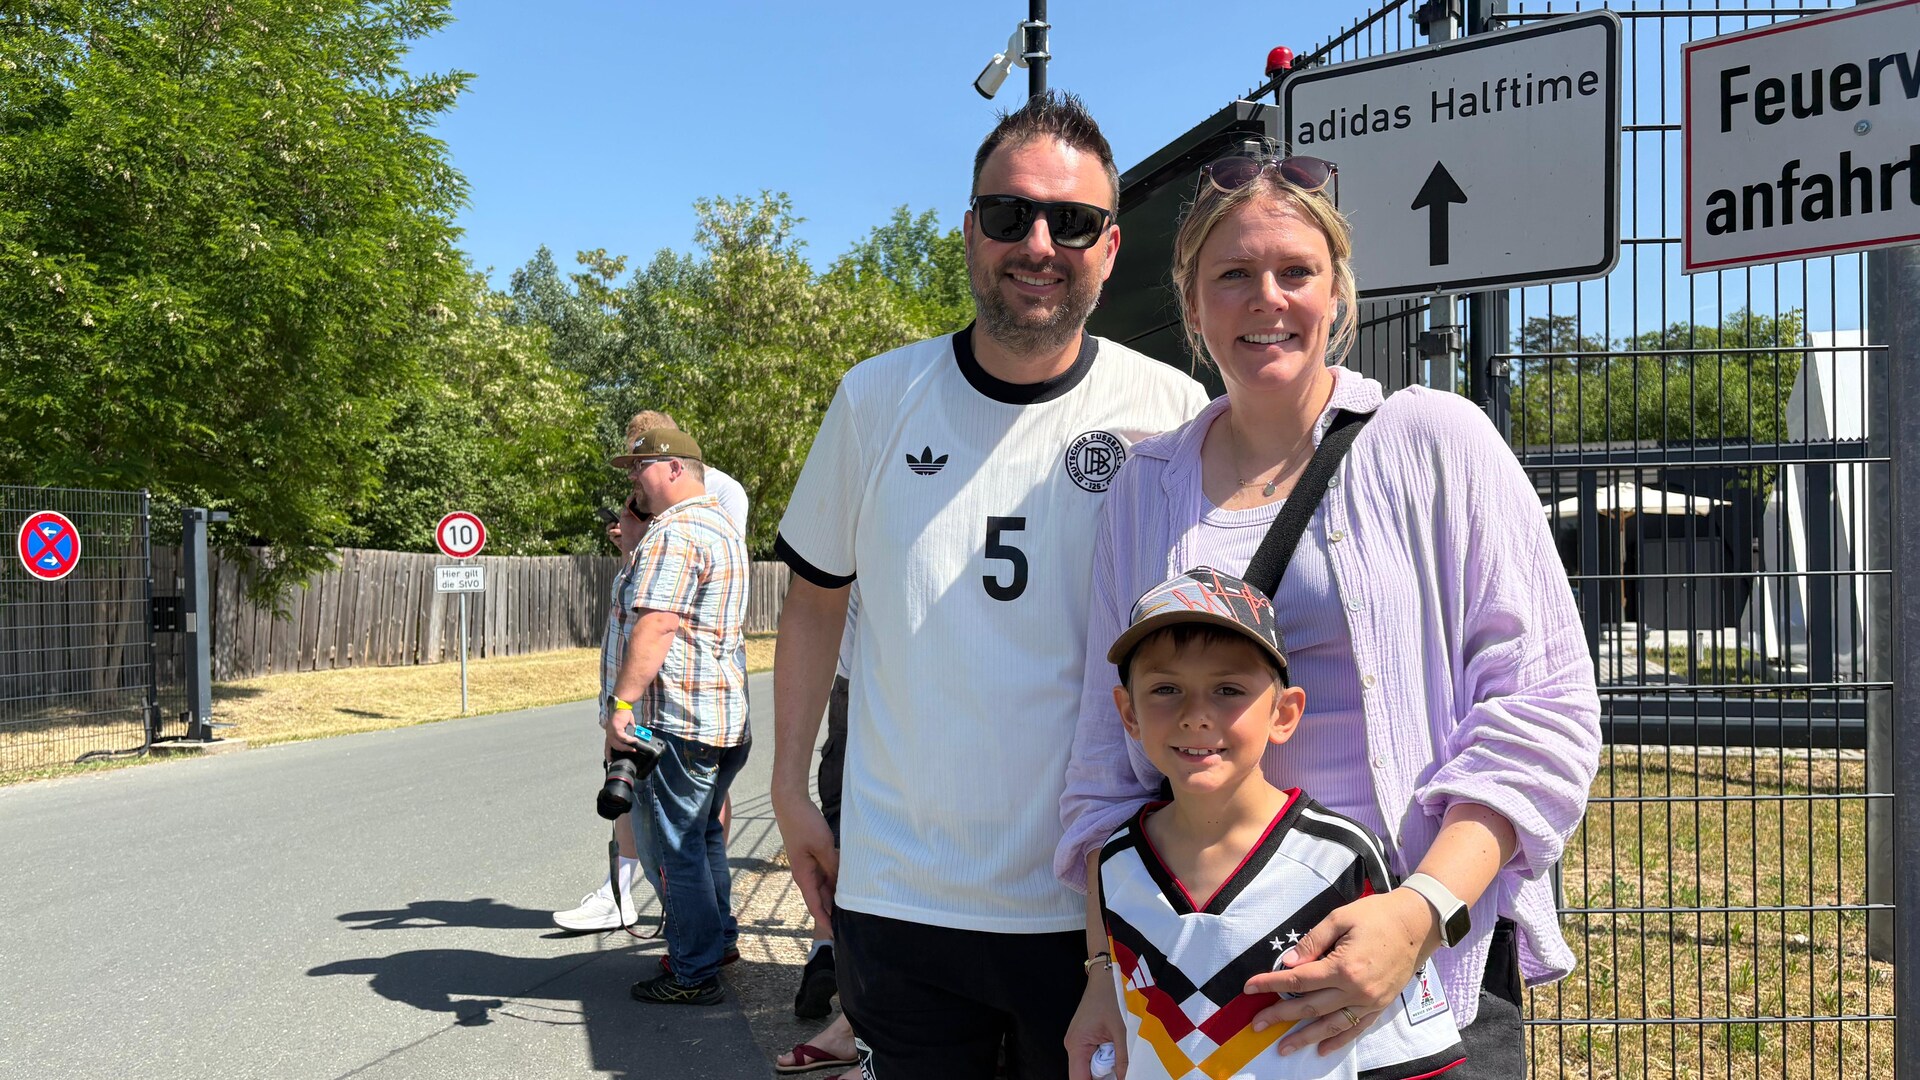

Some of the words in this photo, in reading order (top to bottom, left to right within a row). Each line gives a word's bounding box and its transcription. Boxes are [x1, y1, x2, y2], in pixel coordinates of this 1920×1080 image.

[1298, 104, 1412, 145] adidas
[1432, 70, 1599, 124] Halftime
[1069, 436, 1088, 483] DEUTSCHER
[449, 525, 473, 546] 10
[442, 569, 461, 578] Hier
[464, 569, 479, 580] gilt
[982, 516, 1029, 602] 5
[442, 580, 455, 589] die
[458, 579, 480, 589] StVO
